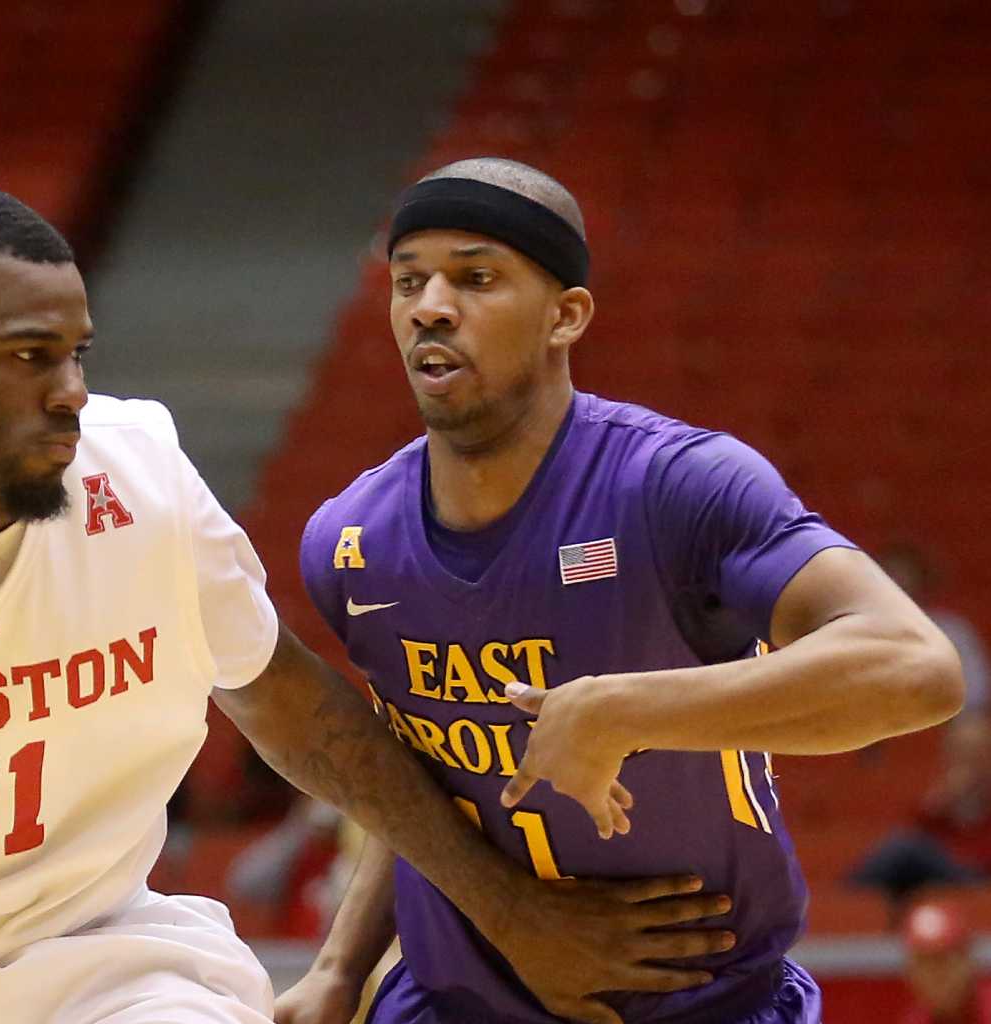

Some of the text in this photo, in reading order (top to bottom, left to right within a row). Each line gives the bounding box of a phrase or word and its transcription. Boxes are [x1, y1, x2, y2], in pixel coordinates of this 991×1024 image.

[82, 472, 134, 537] A
[333, 526, 366, 569] A
[400, 638, 555, 704] EAST
[453, 795, 576, 881] 1
